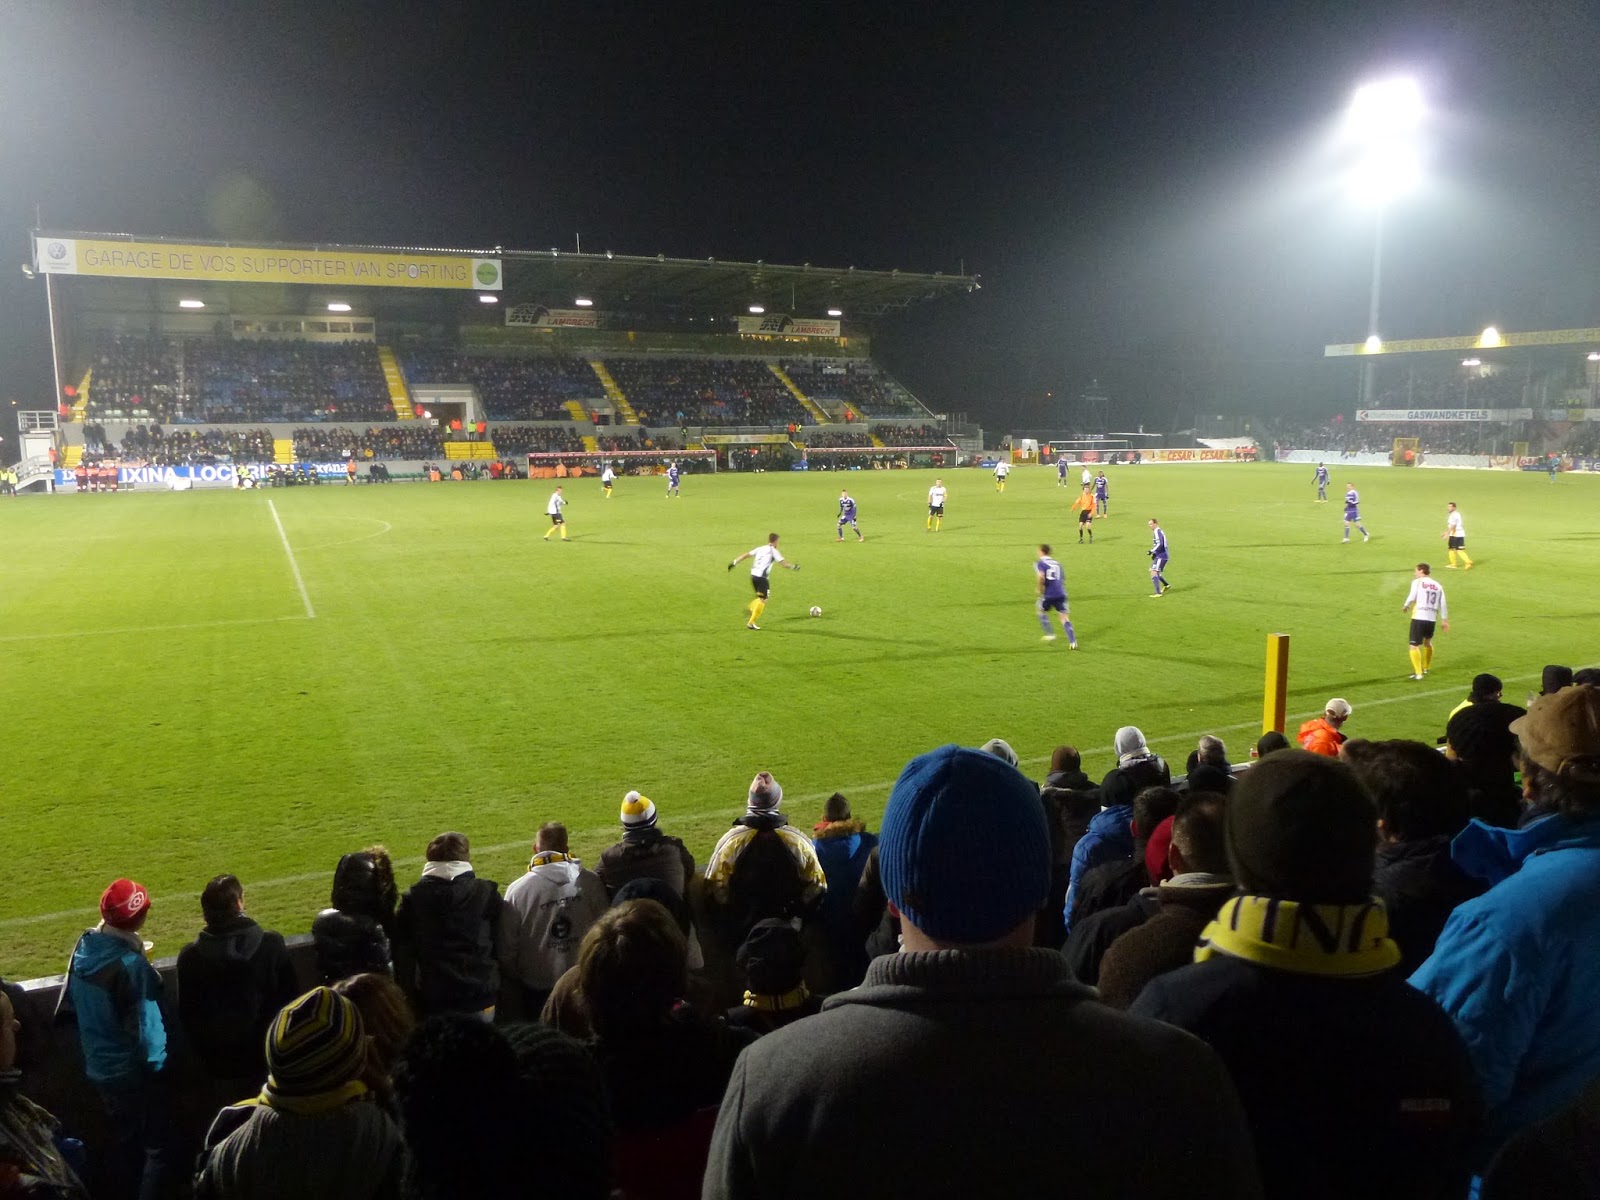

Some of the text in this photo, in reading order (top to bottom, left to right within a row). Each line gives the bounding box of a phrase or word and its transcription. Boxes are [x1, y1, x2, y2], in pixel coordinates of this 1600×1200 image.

[84, 249, 467, 281] GARAGE DE VOS SUPPORTER VAN SPORTING
[791, 325, 836, 335] LAMBRECHT
[1407, 410, 1489, 420] GASWANDKETELS
[122, 466, 177, 483] IXINA
[1426, 591, 1437, 605] 13
